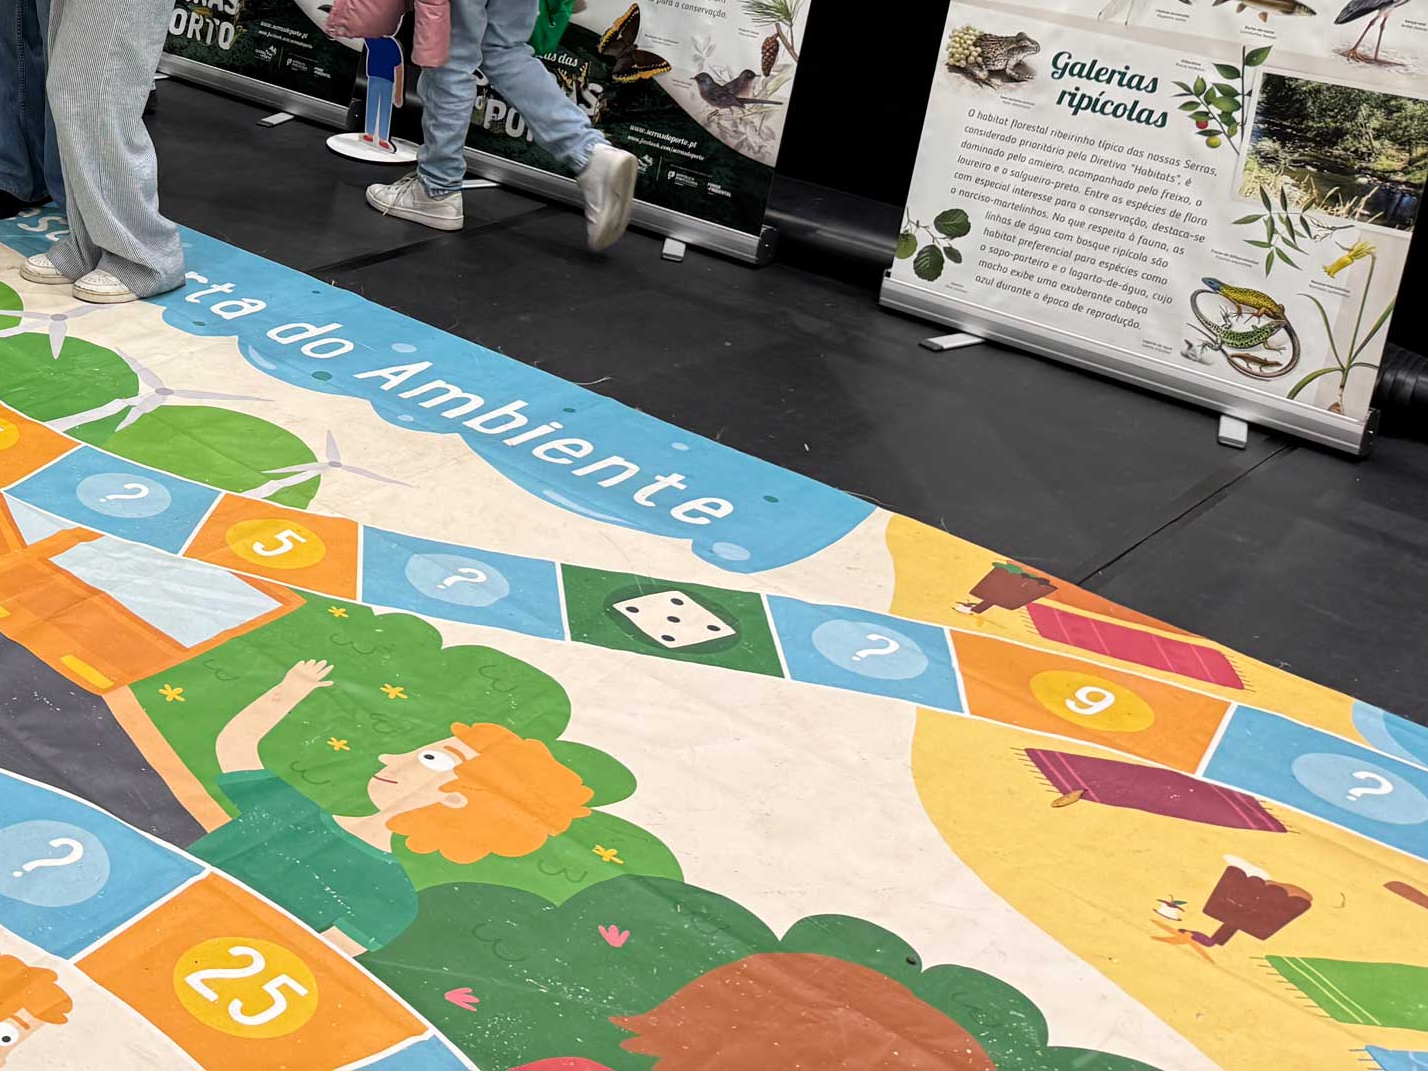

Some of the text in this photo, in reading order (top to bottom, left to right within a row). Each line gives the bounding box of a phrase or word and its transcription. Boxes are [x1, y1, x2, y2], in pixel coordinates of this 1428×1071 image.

[168, 9, 236, 50] ORTO
[1050, 50, 1159, 95] Galerias
[1056, 85, 1169, 130] ripícolas
[967, 108, 1218, 177] O habitat florestal ribeirinho típico das nossas Serras,
[265, 320, 355, 360] do
[353, 361, 735, 527] Ambiente
[99, 482, 150, 504] ?
[252, 529, 307, 556] 5
[436, 567, 489, 590] ?
[851, 633, 901, 662] ?
[1064, 686, 1116, 716] 9
[1345, 769, 1394, 802] ?
[12, 836, 85, 879] ?
[184, 944, 309, 1027] 25
